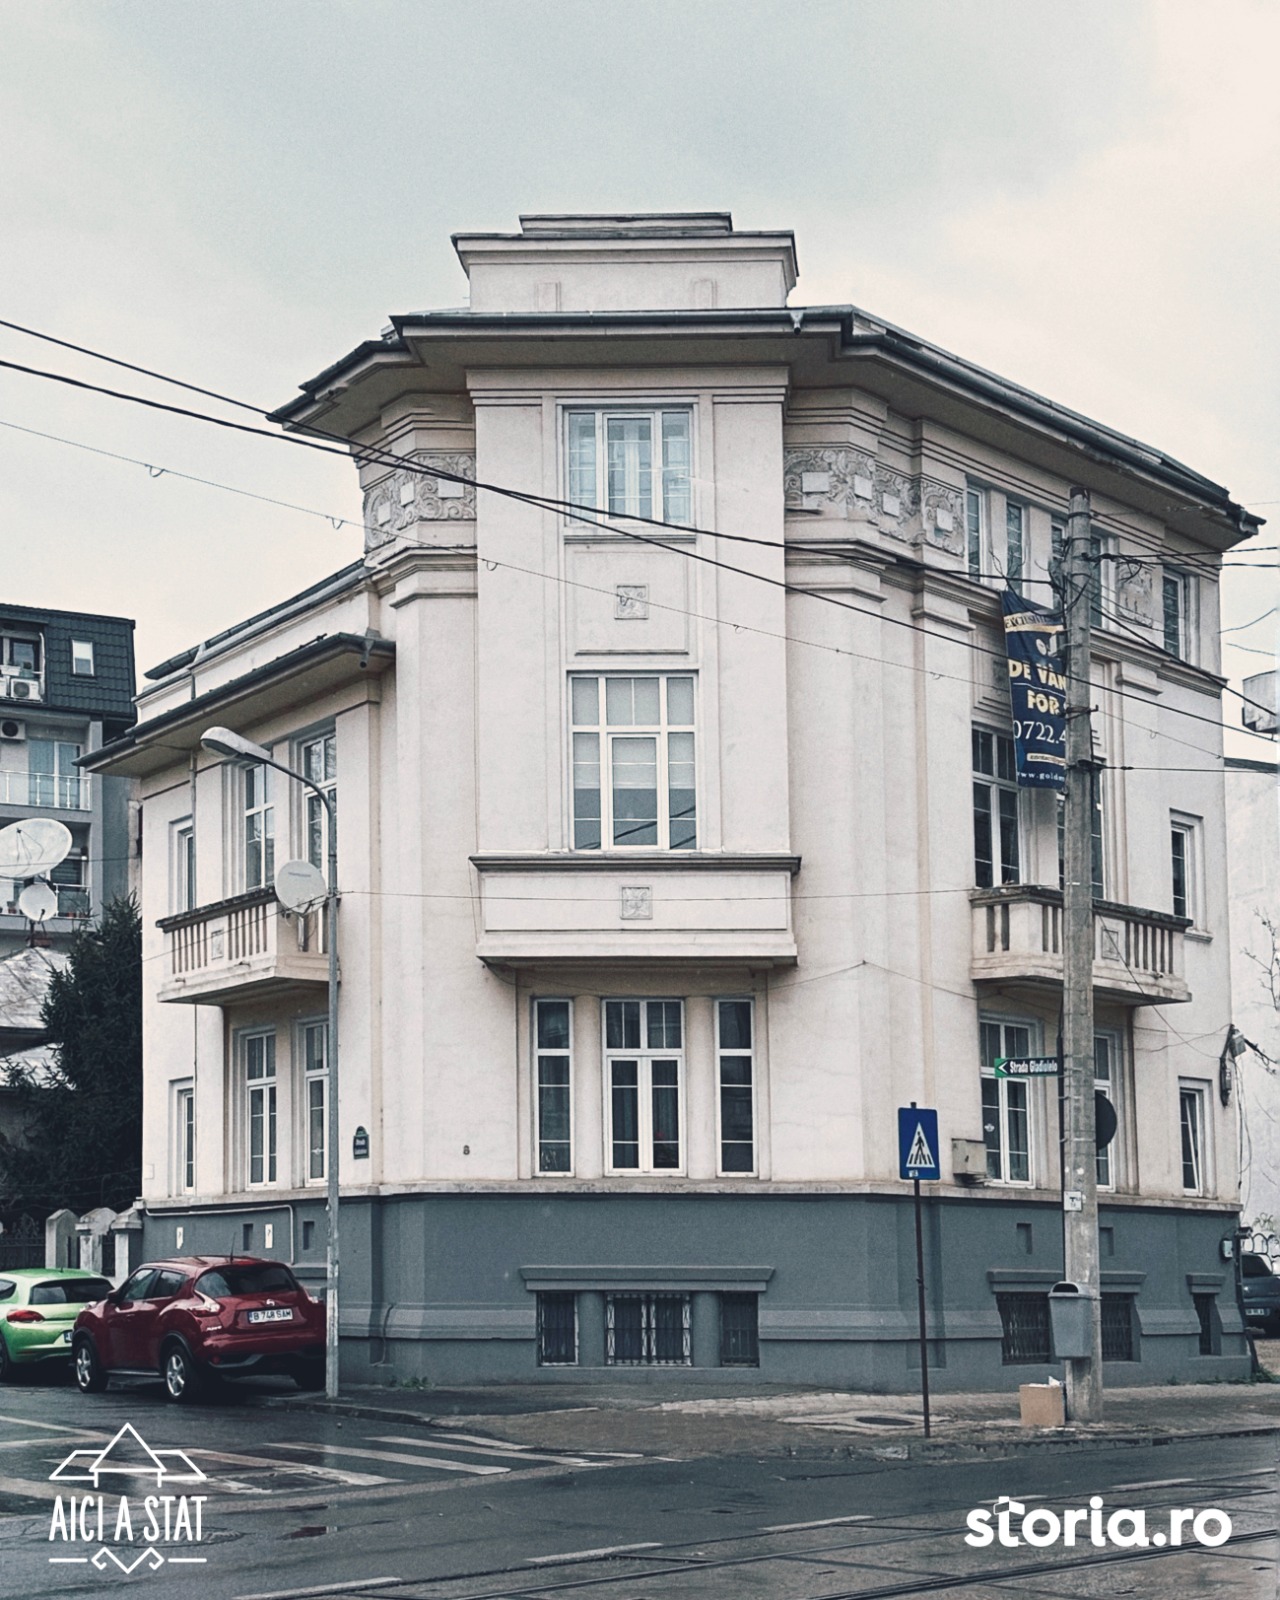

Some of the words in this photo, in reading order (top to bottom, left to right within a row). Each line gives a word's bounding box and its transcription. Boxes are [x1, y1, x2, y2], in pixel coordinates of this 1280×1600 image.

[1008, 659, 1031, 681] DE
[1027, 689, 1059, 715] FOR
[1010, 1060, 1028, 1073] Strada
[253, 1312, 260, 1320] B
